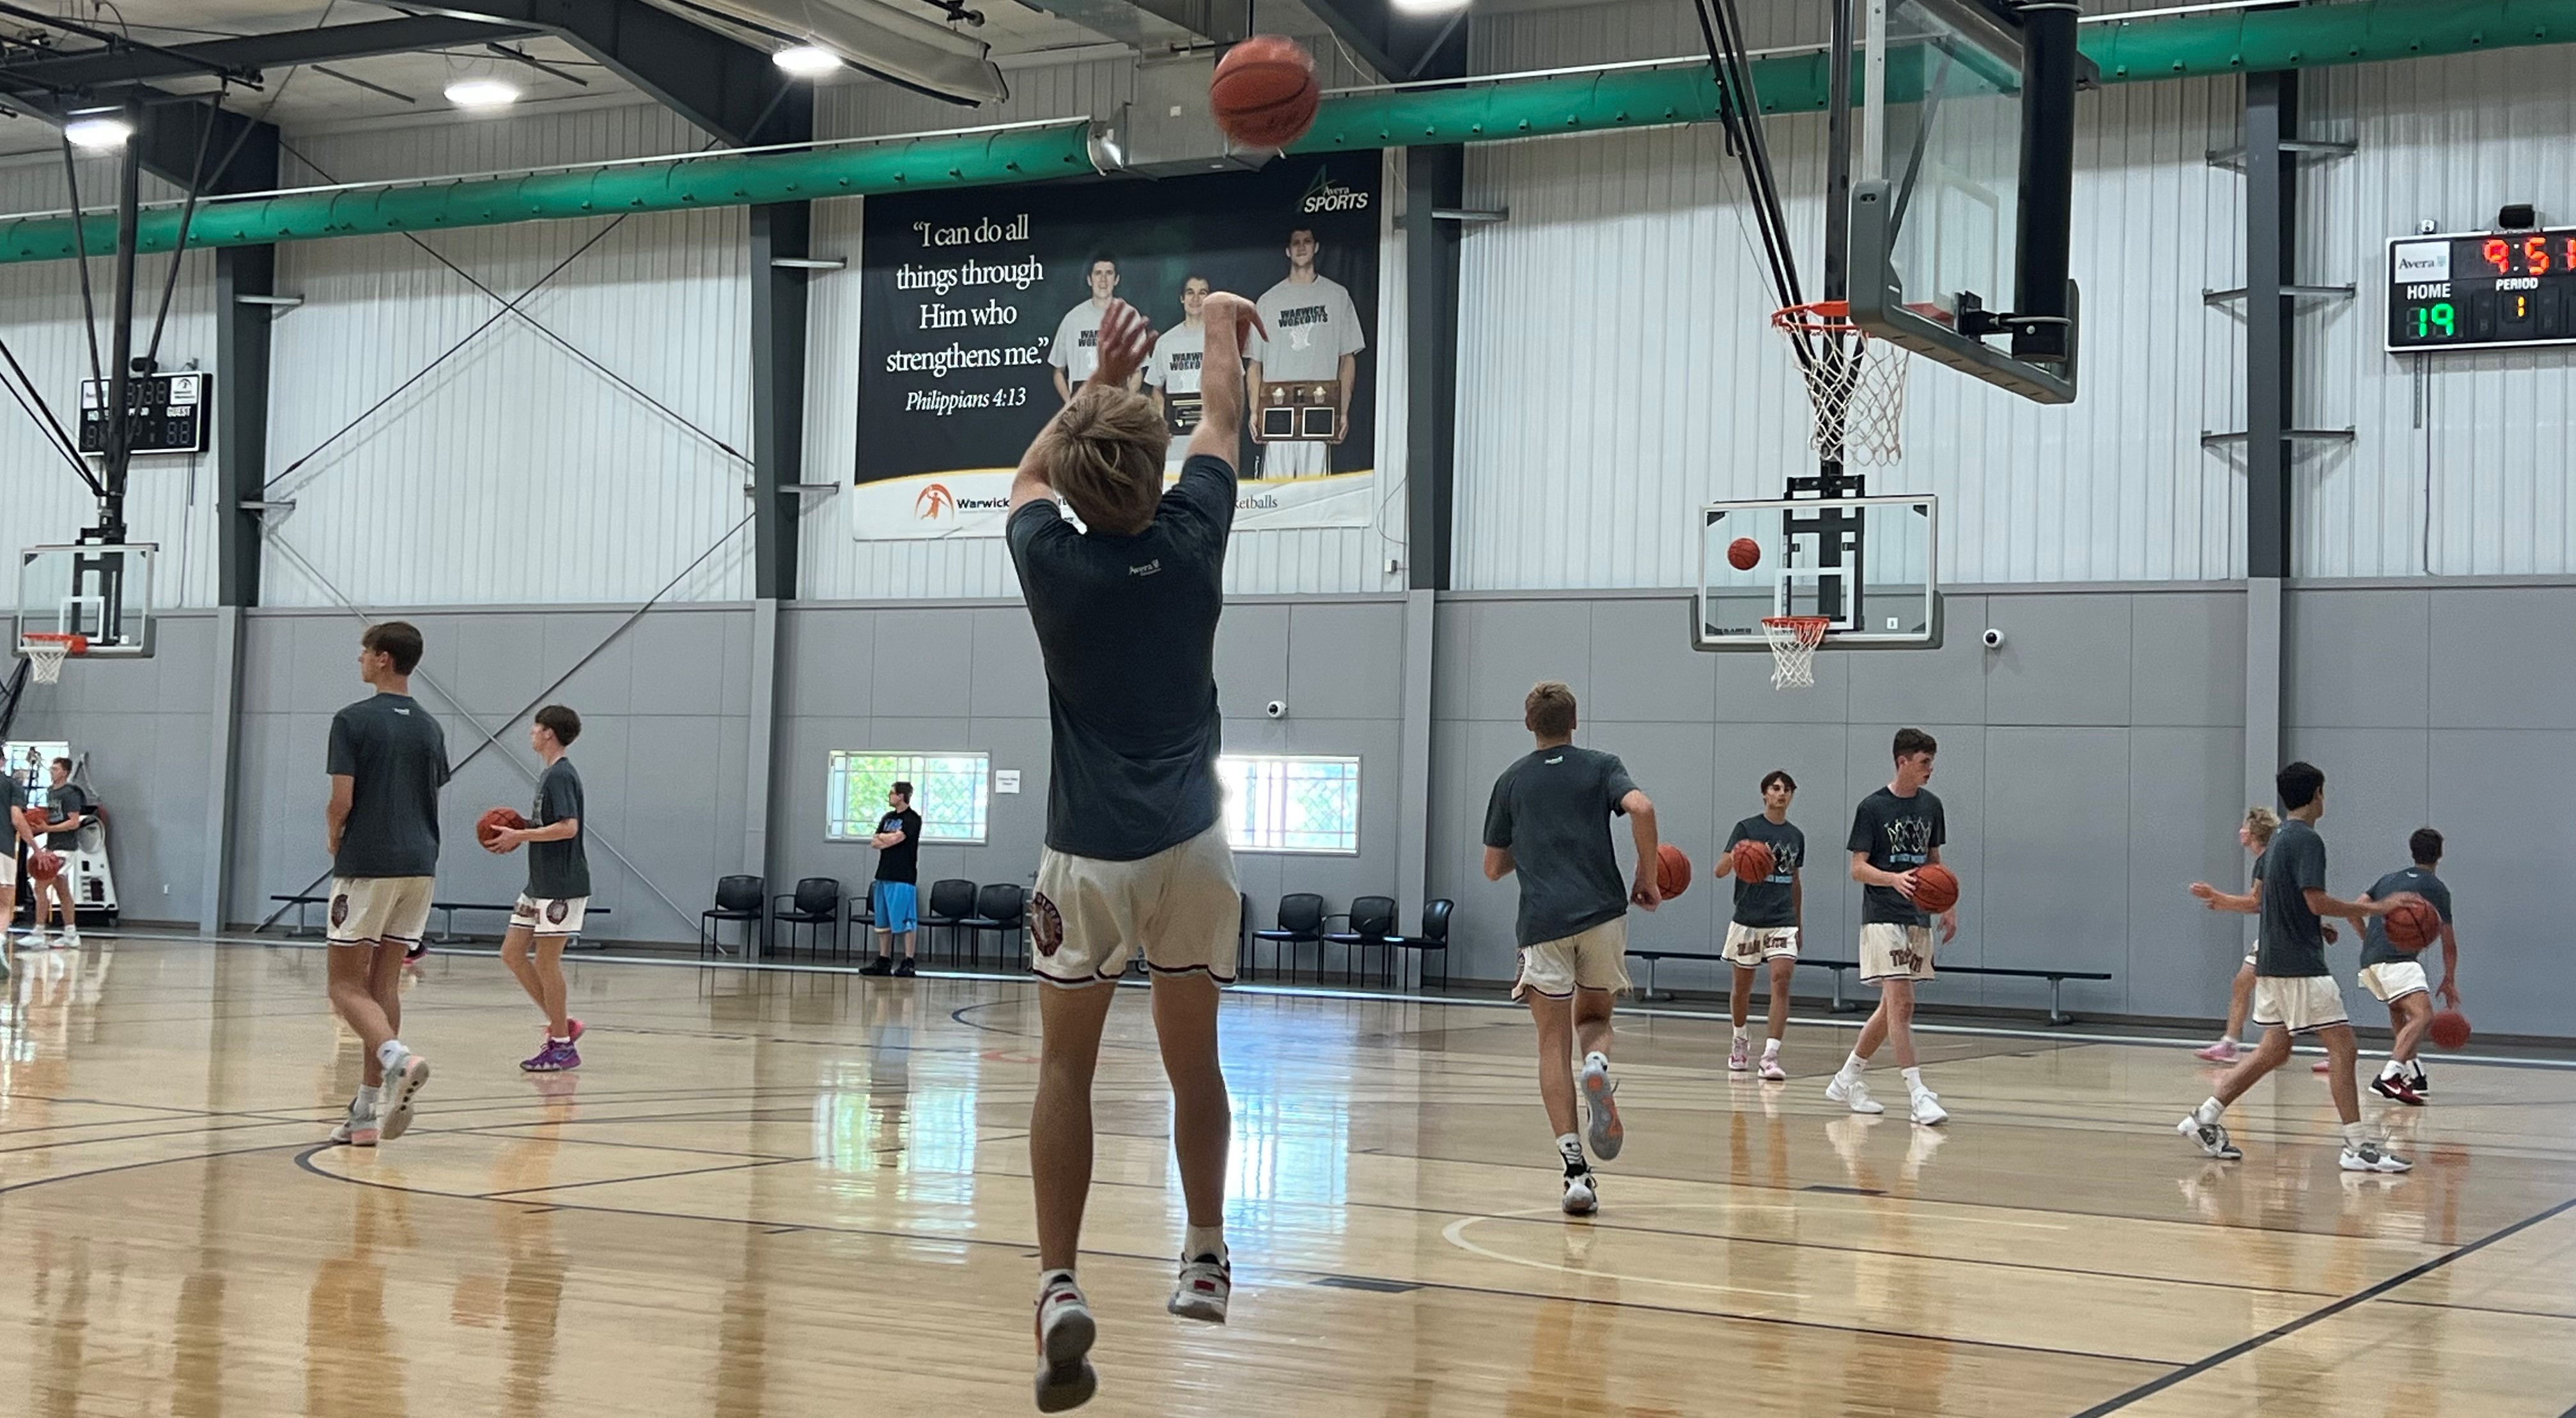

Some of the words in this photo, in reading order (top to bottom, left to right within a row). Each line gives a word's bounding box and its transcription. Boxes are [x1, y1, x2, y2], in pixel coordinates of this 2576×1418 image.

[1304, 192, 1368, 213] SPORTS
[935, 225, 970, 245] can
[974, 217, 1002, 243] do
[1005, 213, 1029, 240] all
[896, 263, 958, 295] things
[961, 254, 1044, 290] through
[2398, 258, 2435, 270] Avera
[2407, 283, 2451, 300] HOME
[2495, 277, 2539, 291] PERIOD
[919, 303, 967, 329] Him
[970, 298, 1017, 326] who
[1280, 305, 1328, 318] WARWICK
[2518, 295, 2525, 317] 1
[2419, 302, 2455, 338] 19
[886, 342, 1000, 378] strengthens
[905, 389, 989, 416] Philippians
[992, 387, 1027, 407] 4:13
[956, 497, 1010, 509] Warwick
